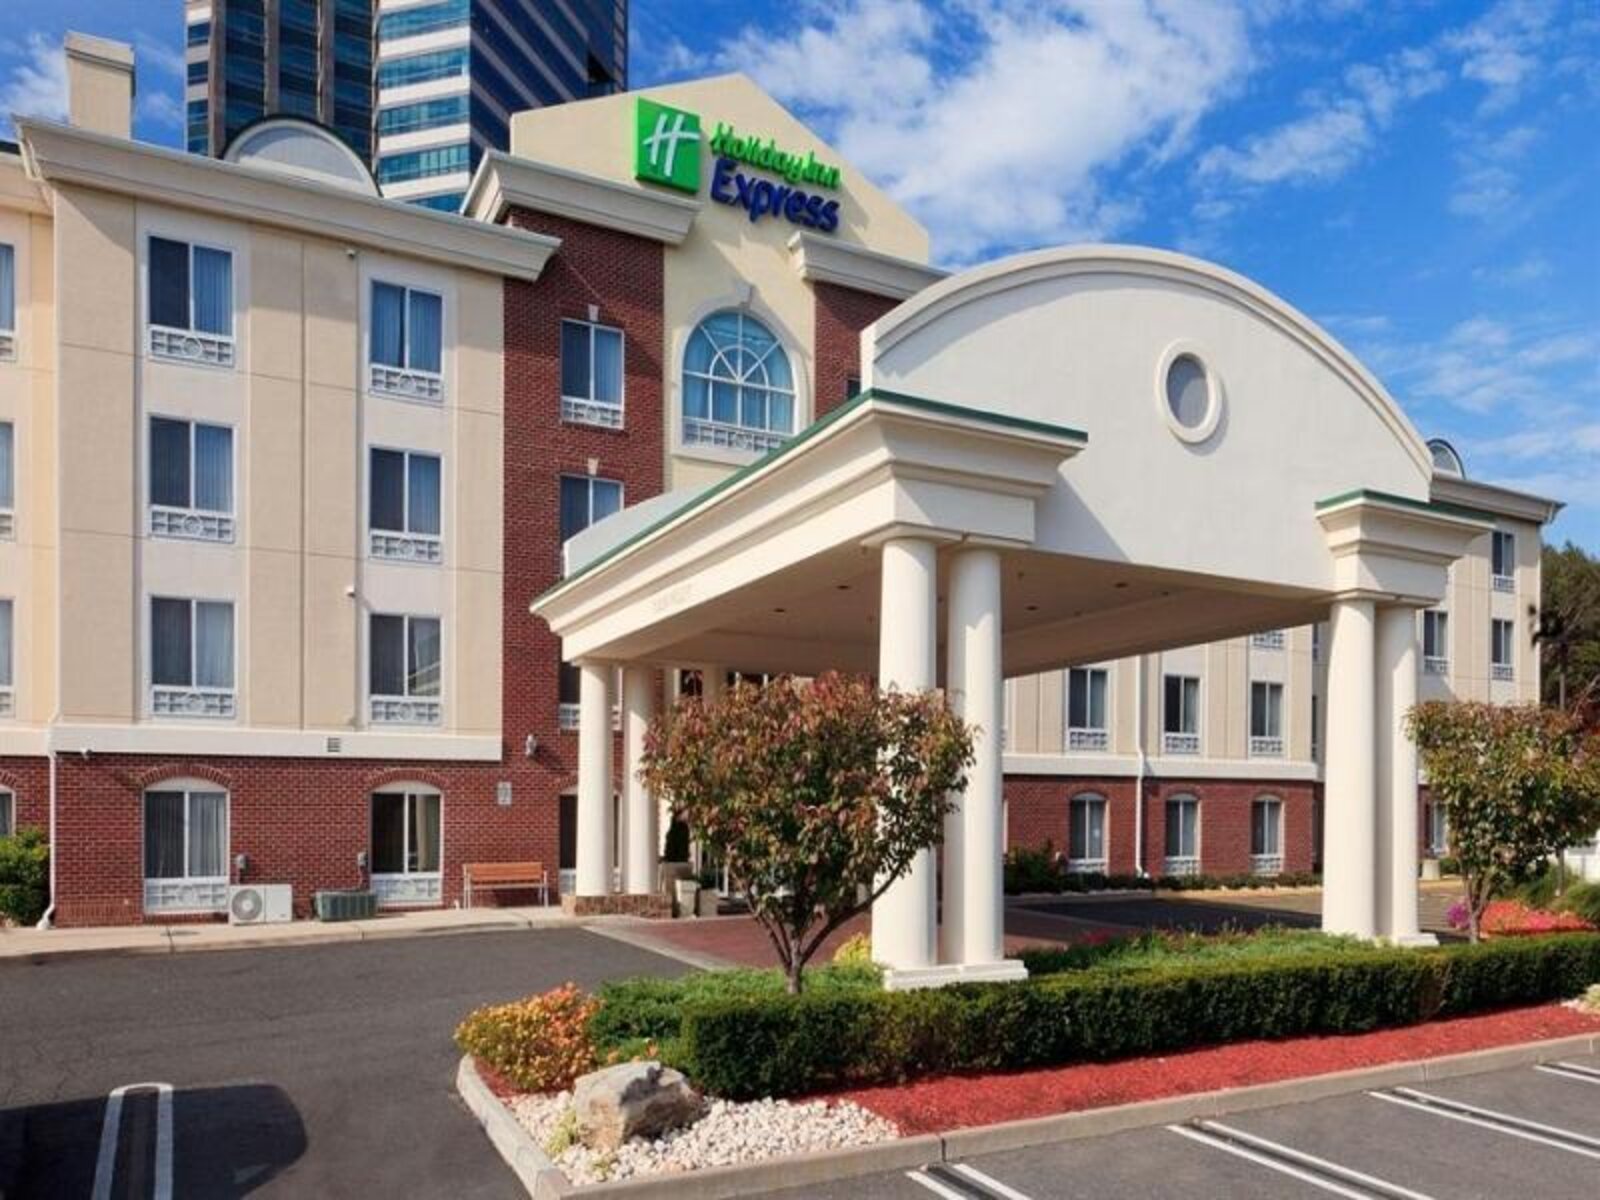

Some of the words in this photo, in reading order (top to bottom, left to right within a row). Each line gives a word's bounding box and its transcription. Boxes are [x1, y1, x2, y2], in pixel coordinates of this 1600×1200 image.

[642, 113, 700, 176] H
[709, 122, 802, 183] Holiday
[802, 150, 841, 189] Inn
[711, 157, 840, 232] Express
